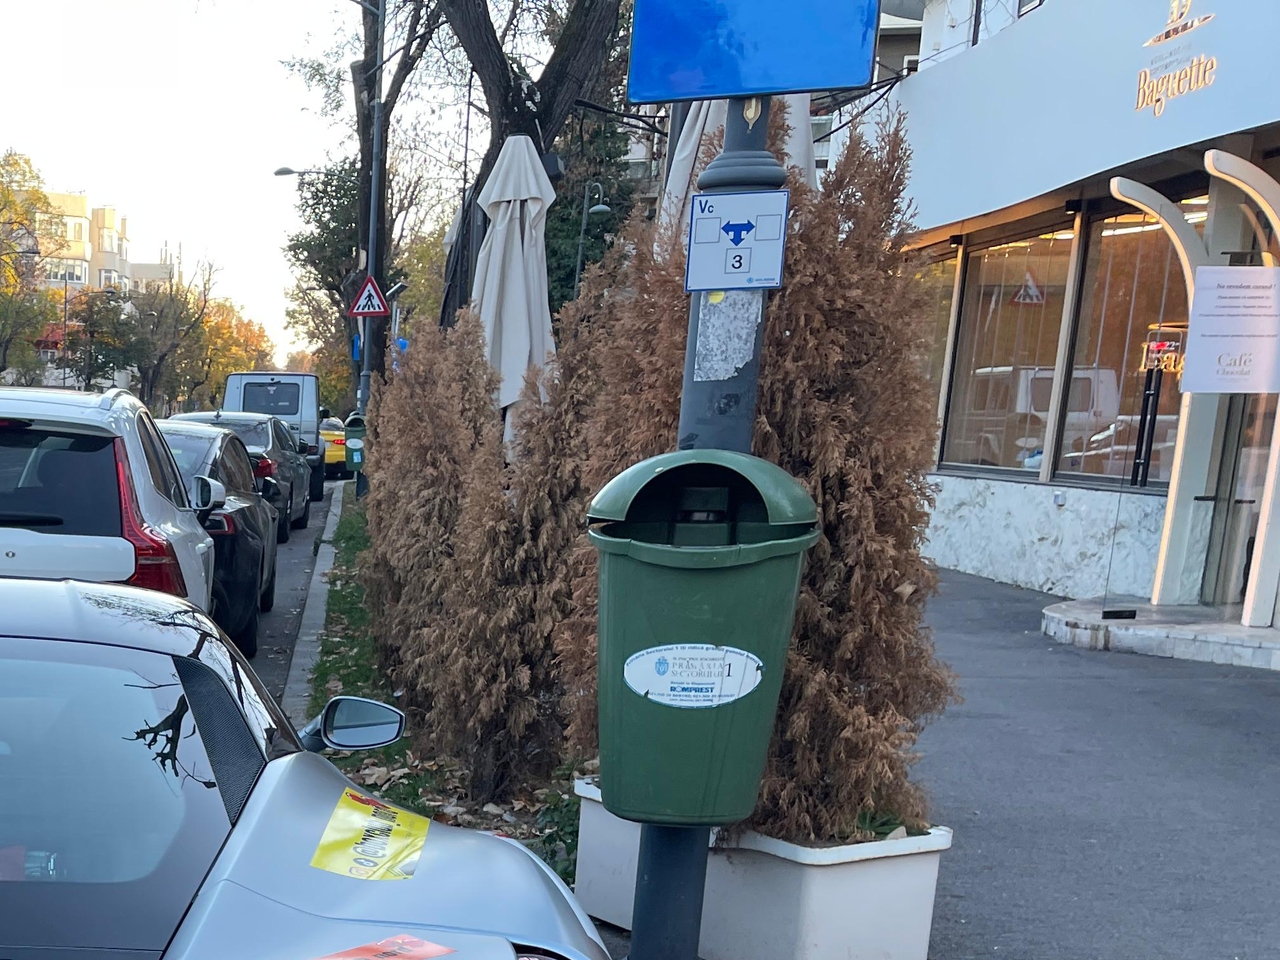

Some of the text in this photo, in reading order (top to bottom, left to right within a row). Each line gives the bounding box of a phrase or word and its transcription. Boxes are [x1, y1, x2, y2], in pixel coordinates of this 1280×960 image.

[1134, 54, 1218, 117] Baguette
[731, 254, 743, 270] 3
[1217, 352, 1253, 367] Café
[725, 662, 732, 678] 1
[670, 685, 715, 693] ROMPREST
